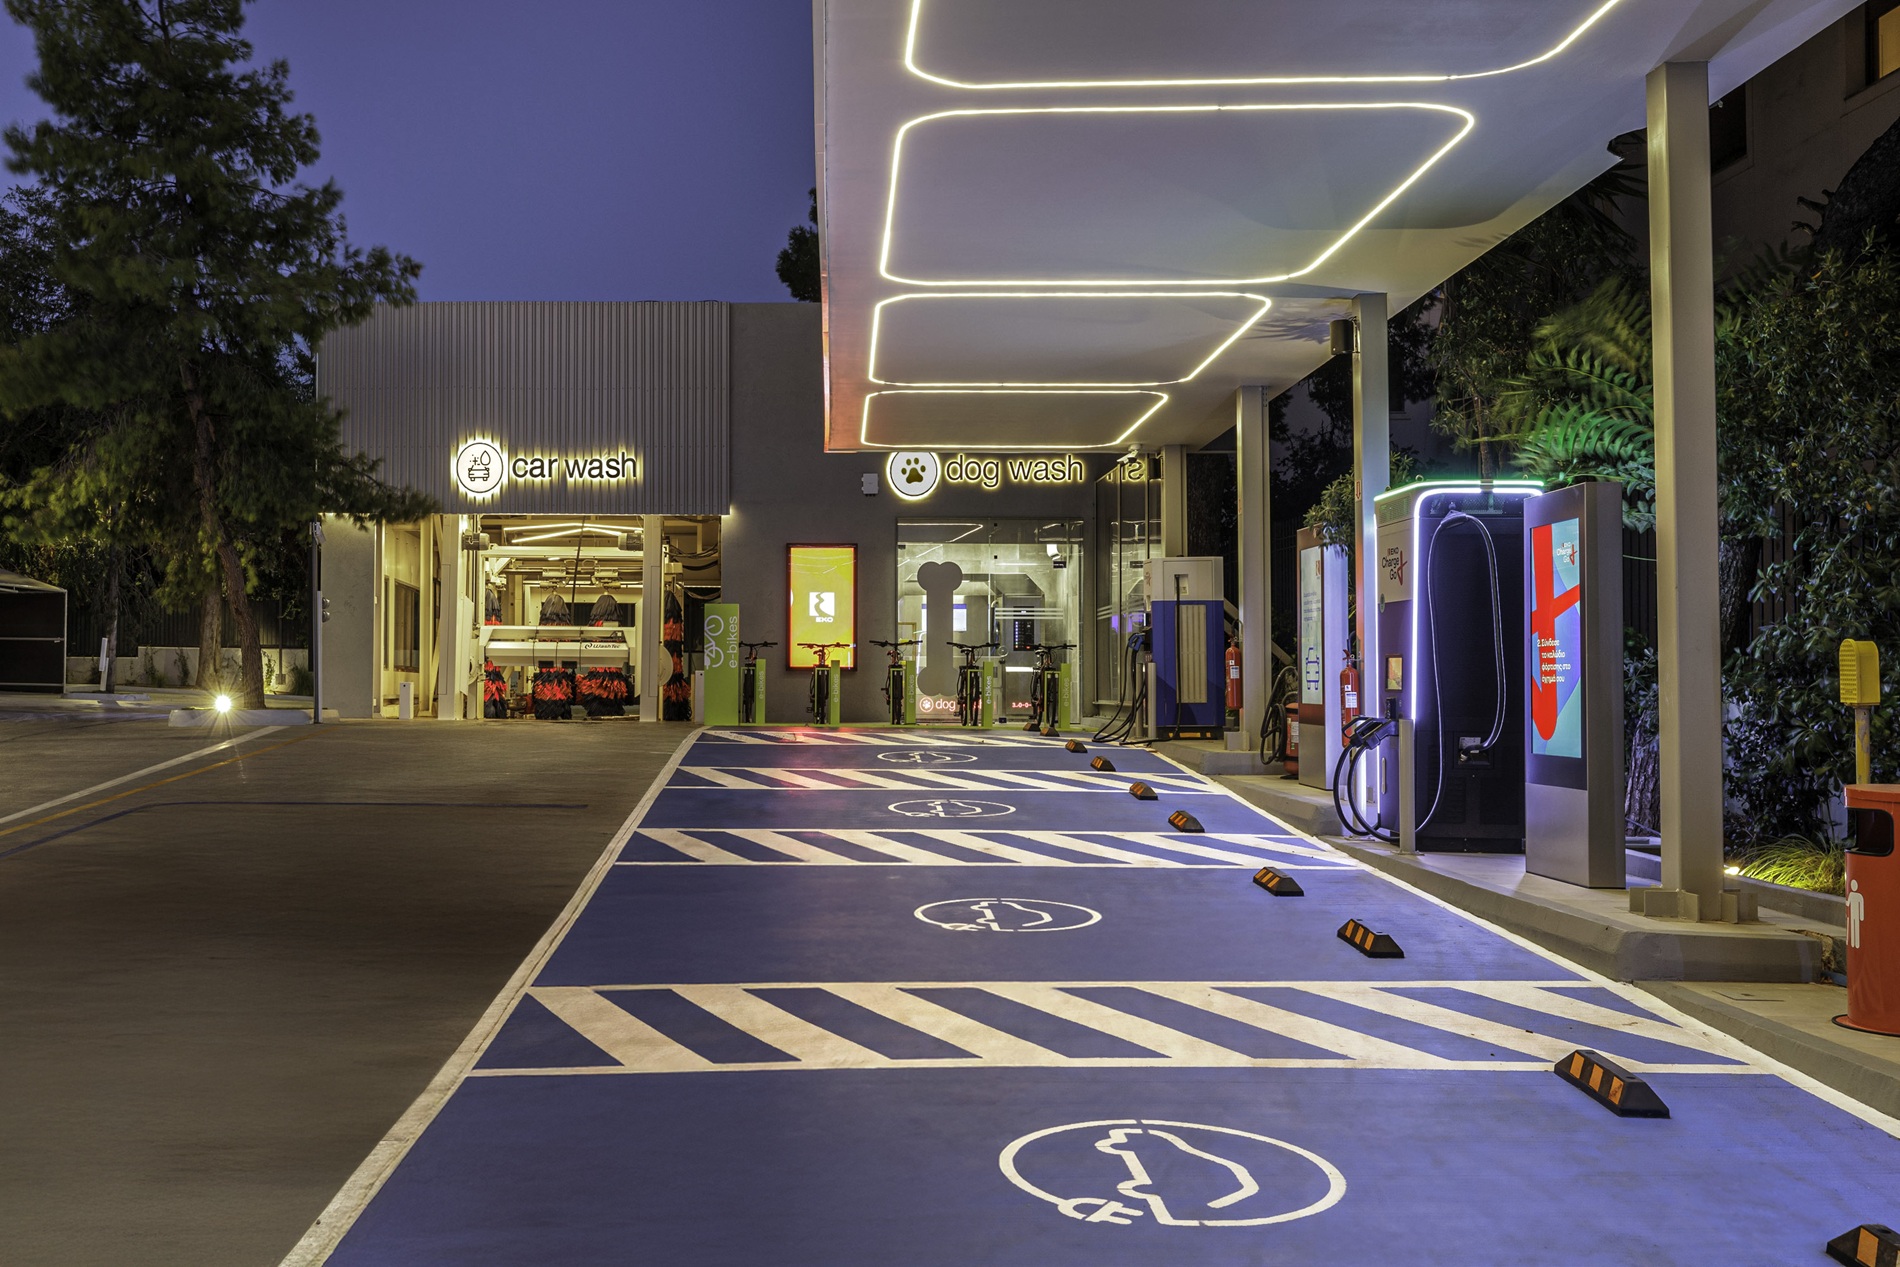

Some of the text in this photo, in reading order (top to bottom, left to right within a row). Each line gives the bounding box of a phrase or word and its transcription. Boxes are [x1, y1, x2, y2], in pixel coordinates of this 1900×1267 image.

[512, 451, 637, 479] car wash
[946, 454, 1000, 488] dog
[1009, 454, 1083, 481] wash
[1382, 557, 1399, 569] Charge
[1390, 569, 1398, 580] Go
[727, 615, 738, 668] e-bikes
[935, 698, 956, 712] dog
